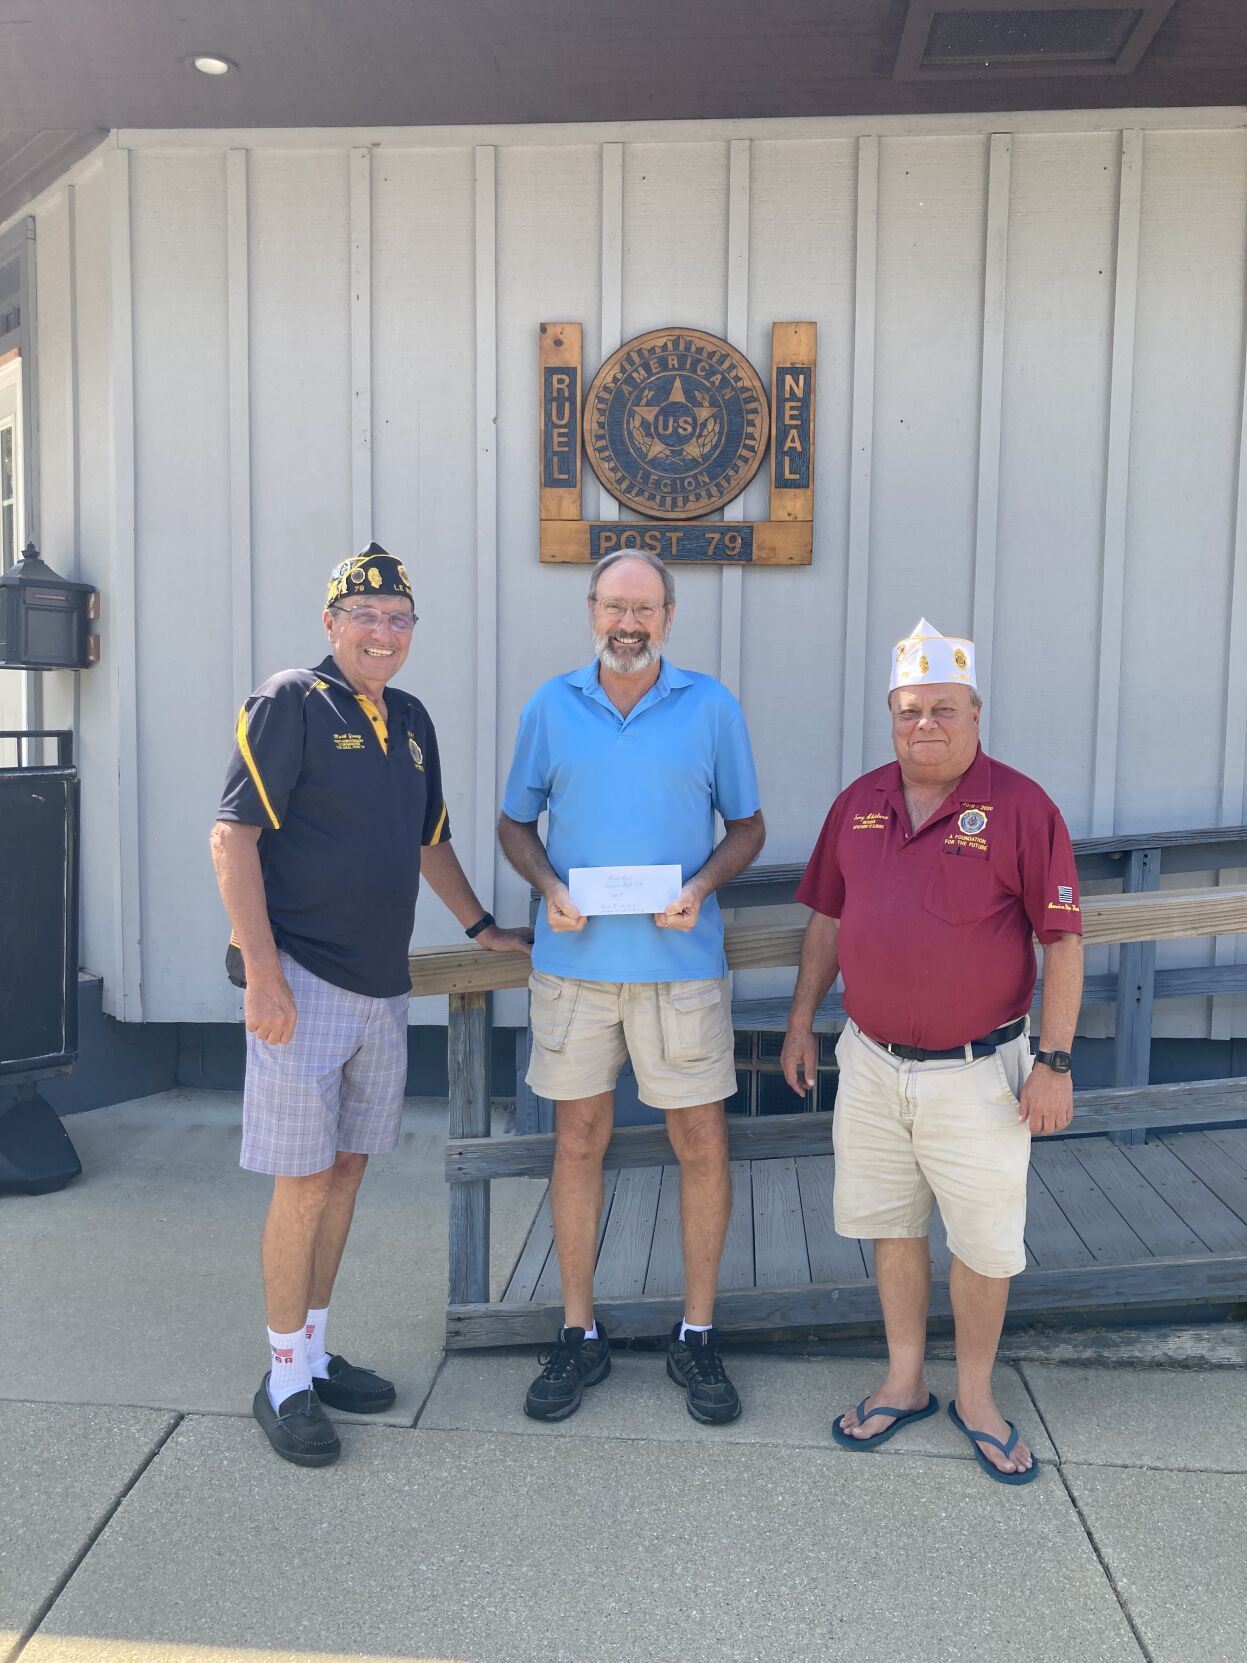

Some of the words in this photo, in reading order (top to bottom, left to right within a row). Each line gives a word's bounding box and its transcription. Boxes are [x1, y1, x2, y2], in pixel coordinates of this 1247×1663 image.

[620, 355, 735, 399] AMERICAN
[552, 374, 570, 480] RUEL
[783, 374, 804, 480] NEAL
[636, 470, 711, 493] LEGION
[600, 531, 684, 555] POST
[704, 532, 742, 556] 79
[354, 584, 365, 592] 79
[955, 834, 987, 845] FOUNDATION
[968, 841, 988, 851] FUTURE
